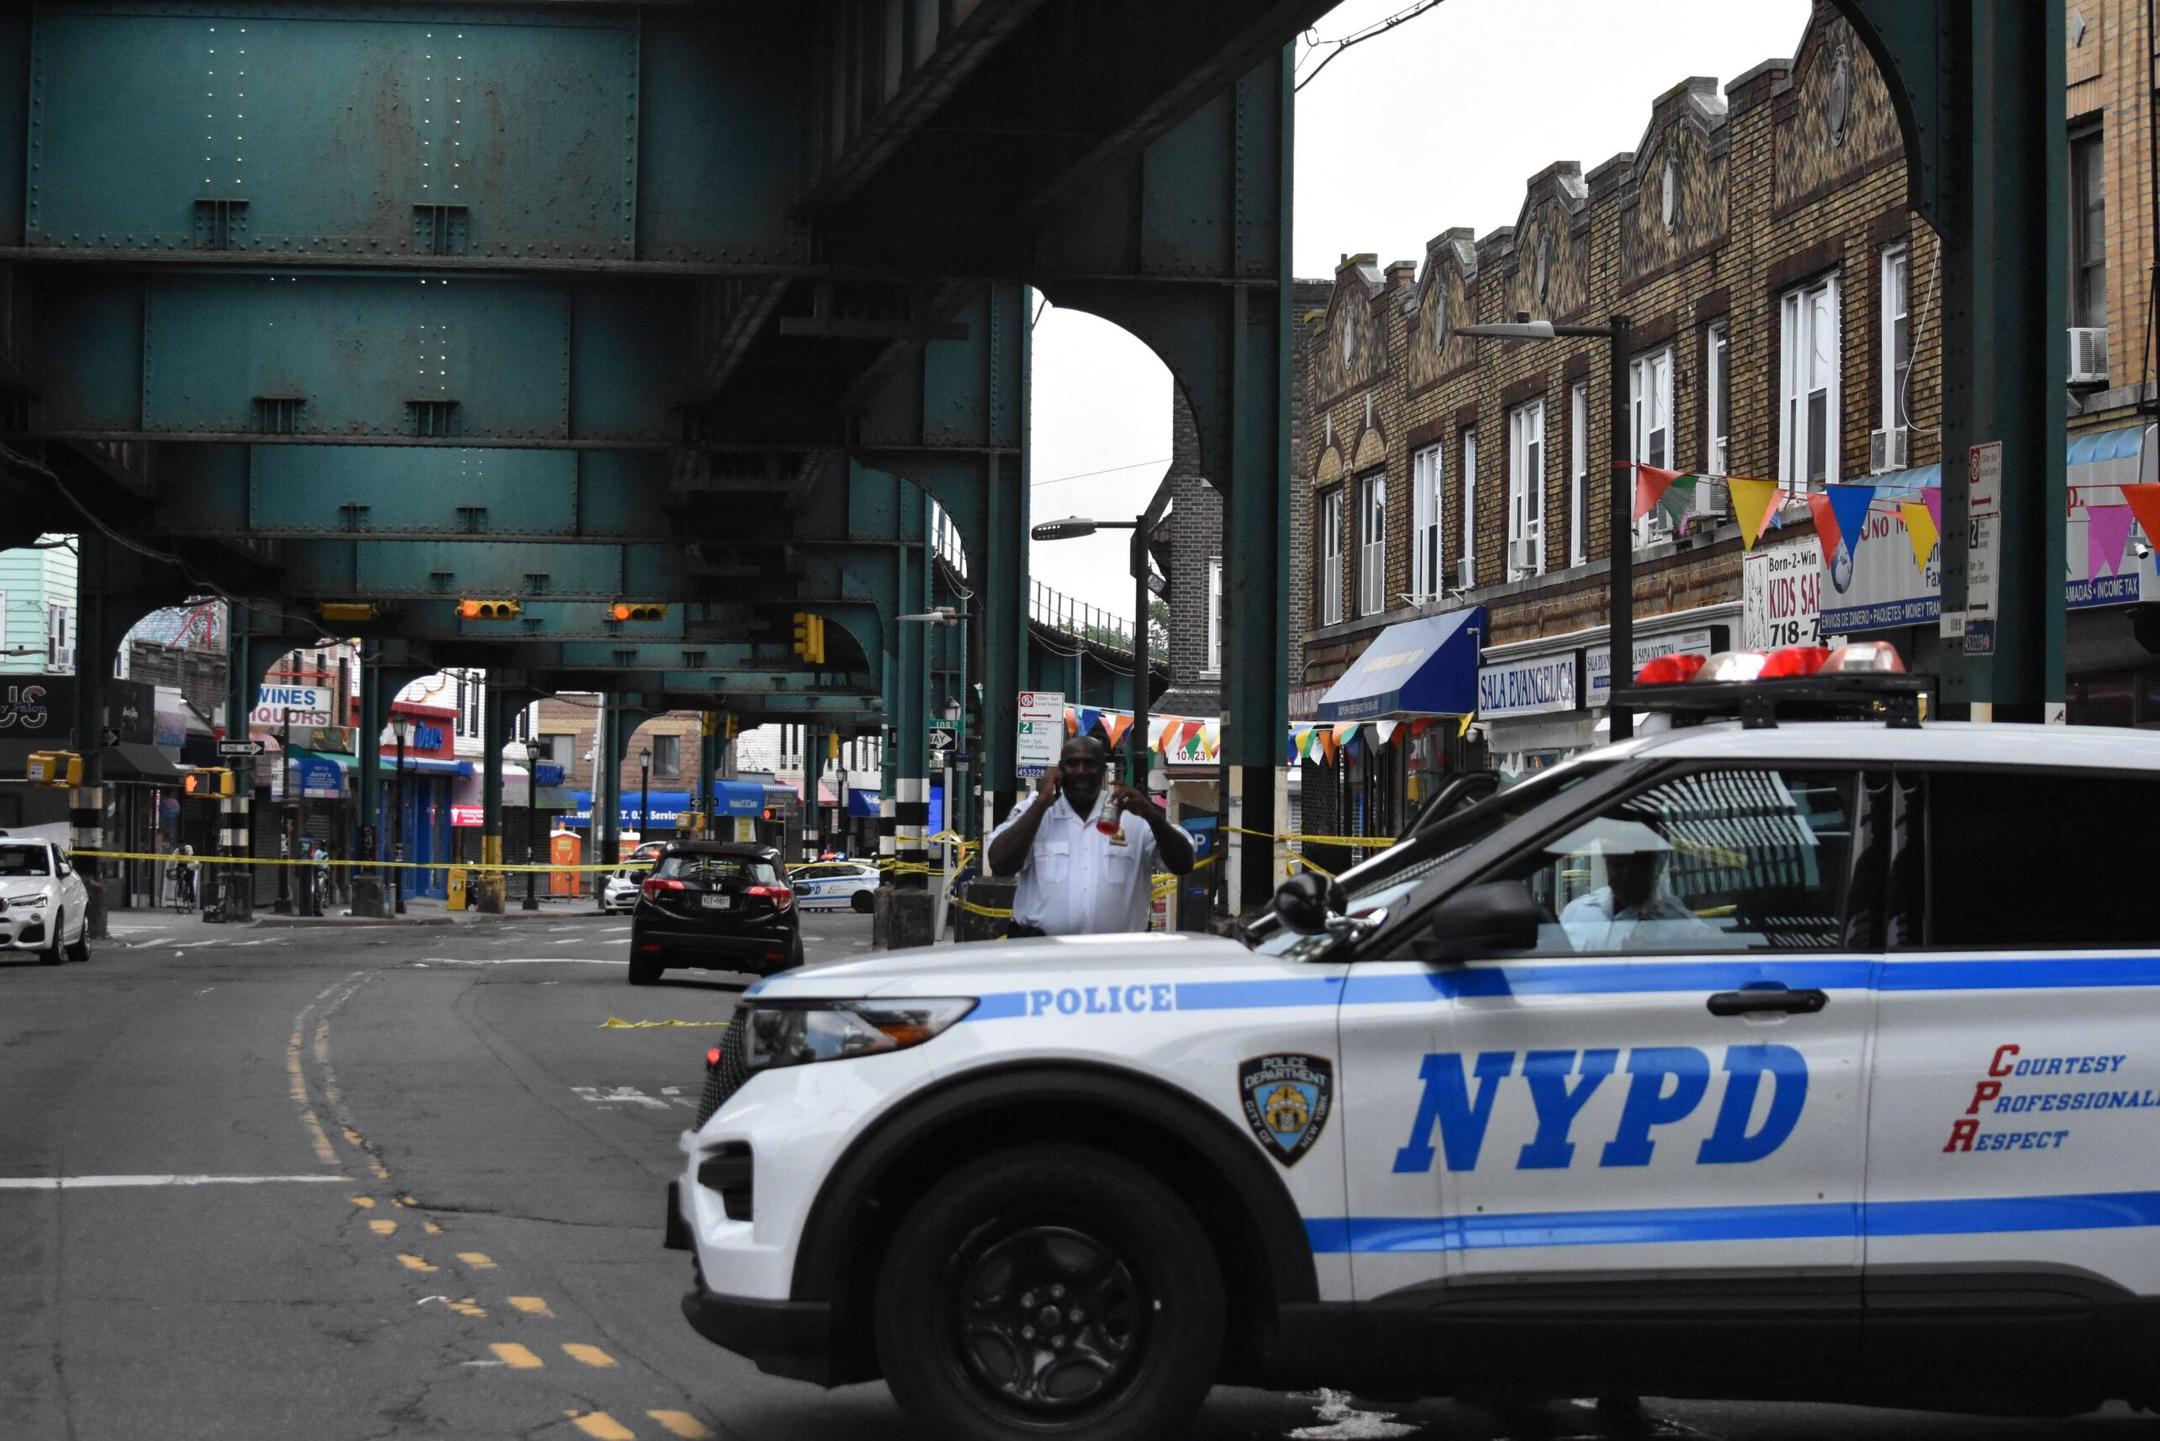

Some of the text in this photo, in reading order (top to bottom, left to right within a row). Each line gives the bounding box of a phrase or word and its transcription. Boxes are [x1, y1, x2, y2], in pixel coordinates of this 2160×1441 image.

[1769, 550, 1817, 573] Born-2-Win
[1769, 576, 1796, 619] KIDS
[1841, 612, 1849, 627] DE
[1873, 605, 1902, 624] PAQUETES
[1905, 602, 1925, 619] MONEY
[2097, 579, 2123, 599] INCOME
[2125, 577, 2138, 596] TAX
[1480, 662, 1575, 712] SALA EVANGELICA
[1029, 984, 1176, 1017] POLICE
[1244, 1067, 1328, 1089] DEPARTMENT
[1262, 1056, 1308, 1070] POLICE
[1988, 1044, 2127, 1078] COURTESY
[1244, 1100, 1275, 1145] CITY OF
[1300, 1094, 1329, 1149] NEW YORK
[1392, 1044, 1809, 1174] NYPD
[1942, 1119, 2070, 1153] RESPECT
